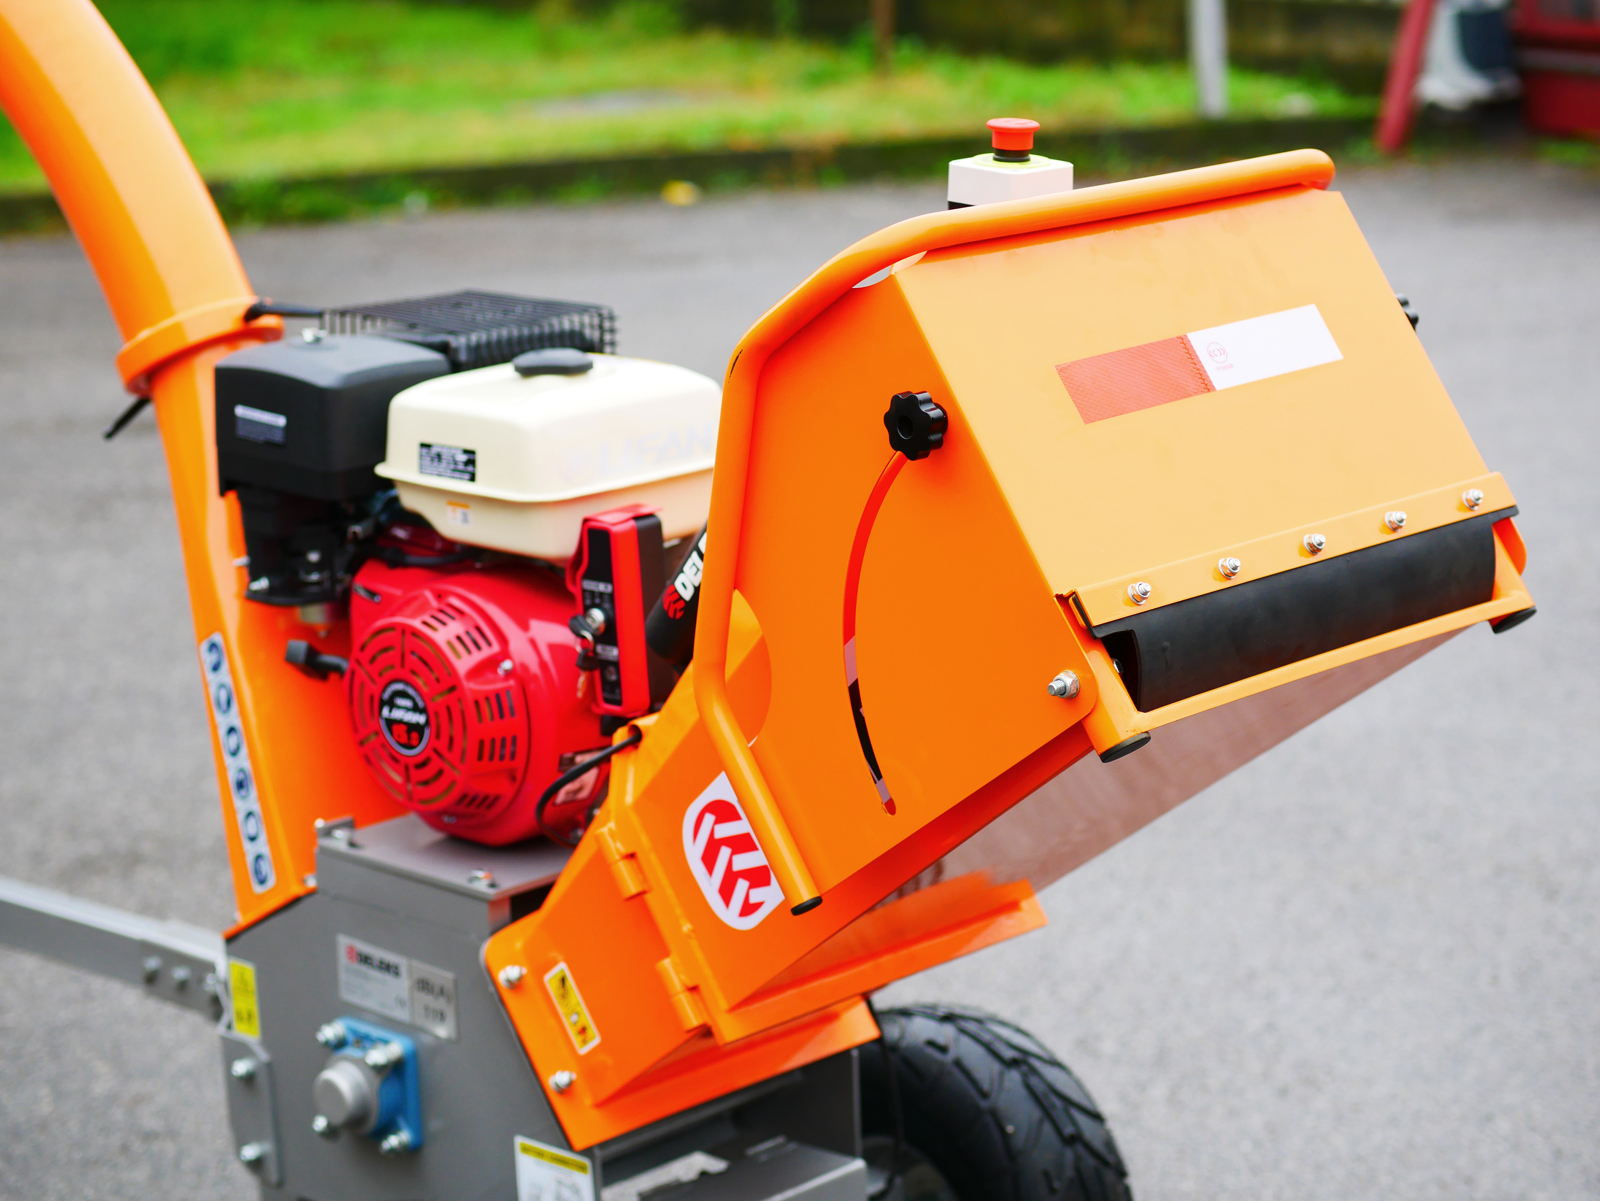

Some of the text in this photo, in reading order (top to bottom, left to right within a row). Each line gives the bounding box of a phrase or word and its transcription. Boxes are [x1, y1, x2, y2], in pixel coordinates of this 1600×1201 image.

[600, 421, 713, 476] LIFAN
[381, 705, 427, 726] LIFAN
[356, 950, 401, 978] DELEKS
